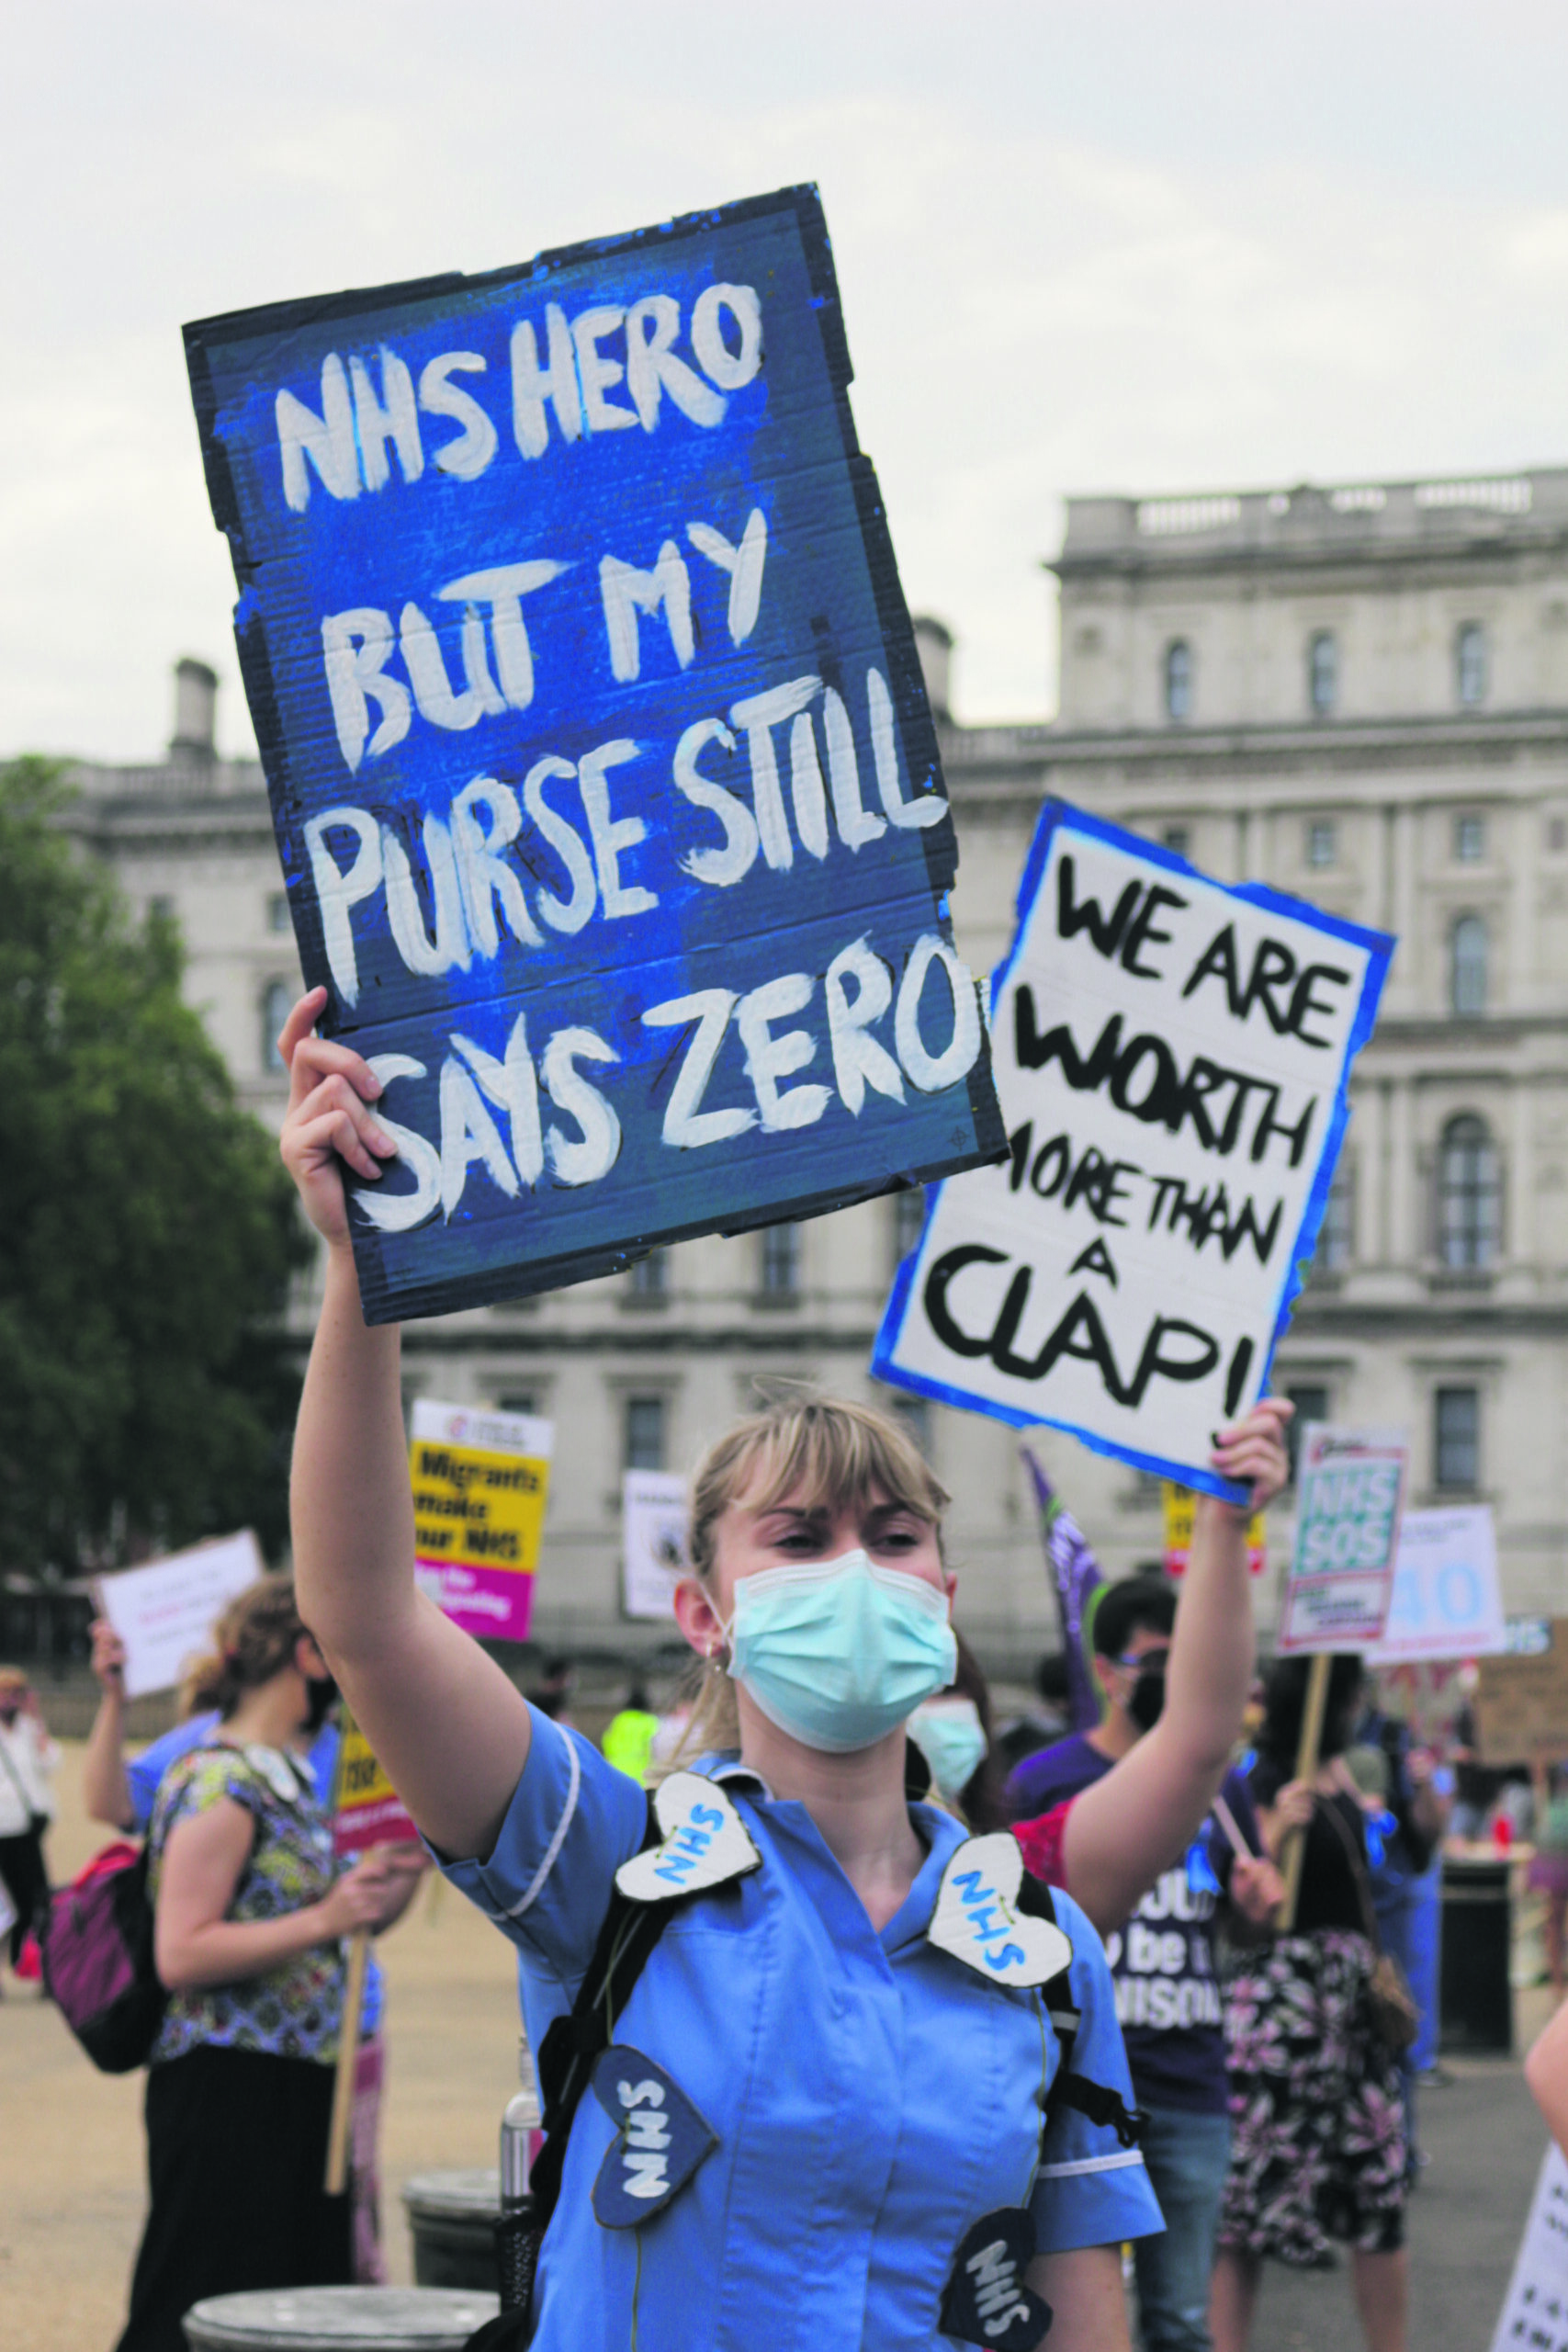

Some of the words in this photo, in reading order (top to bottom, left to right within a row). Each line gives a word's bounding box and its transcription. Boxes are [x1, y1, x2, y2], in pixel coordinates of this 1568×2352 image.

[275, 342, 499, 513] NHS
[511, 283, 764, 460] HERO
[321, 560, 577, 775] BUT
[599, 507, 766, 684] MY
[304, 739, 660, 1008] PURSE
[673, 668, 949, 886] STILL
[1058, 854, 1189, 979] WE
[1182, 923, 1350, 1049] ARE
[351, 1012, 622, 1233] SAYS
[640, 930, 981, 1149] ZERO
[1013, 984, 1317, 1170] WORTH
[1068, 1237, 1119, 1288] A
[1148, 1174, 1284, 1266] THAN
[924, 1243, 1254, 1449] CLAP!
[419, 1450, 539, 1494] Migrants
[416, 1528, 453, 1551] ur
[655, 1803, 725, 1884] NHS
[952, 1870, 1026, 1971] NHS
[616, 2079, 672, 2199] NHS
[965, 2240, 1030, 2337] NHS
